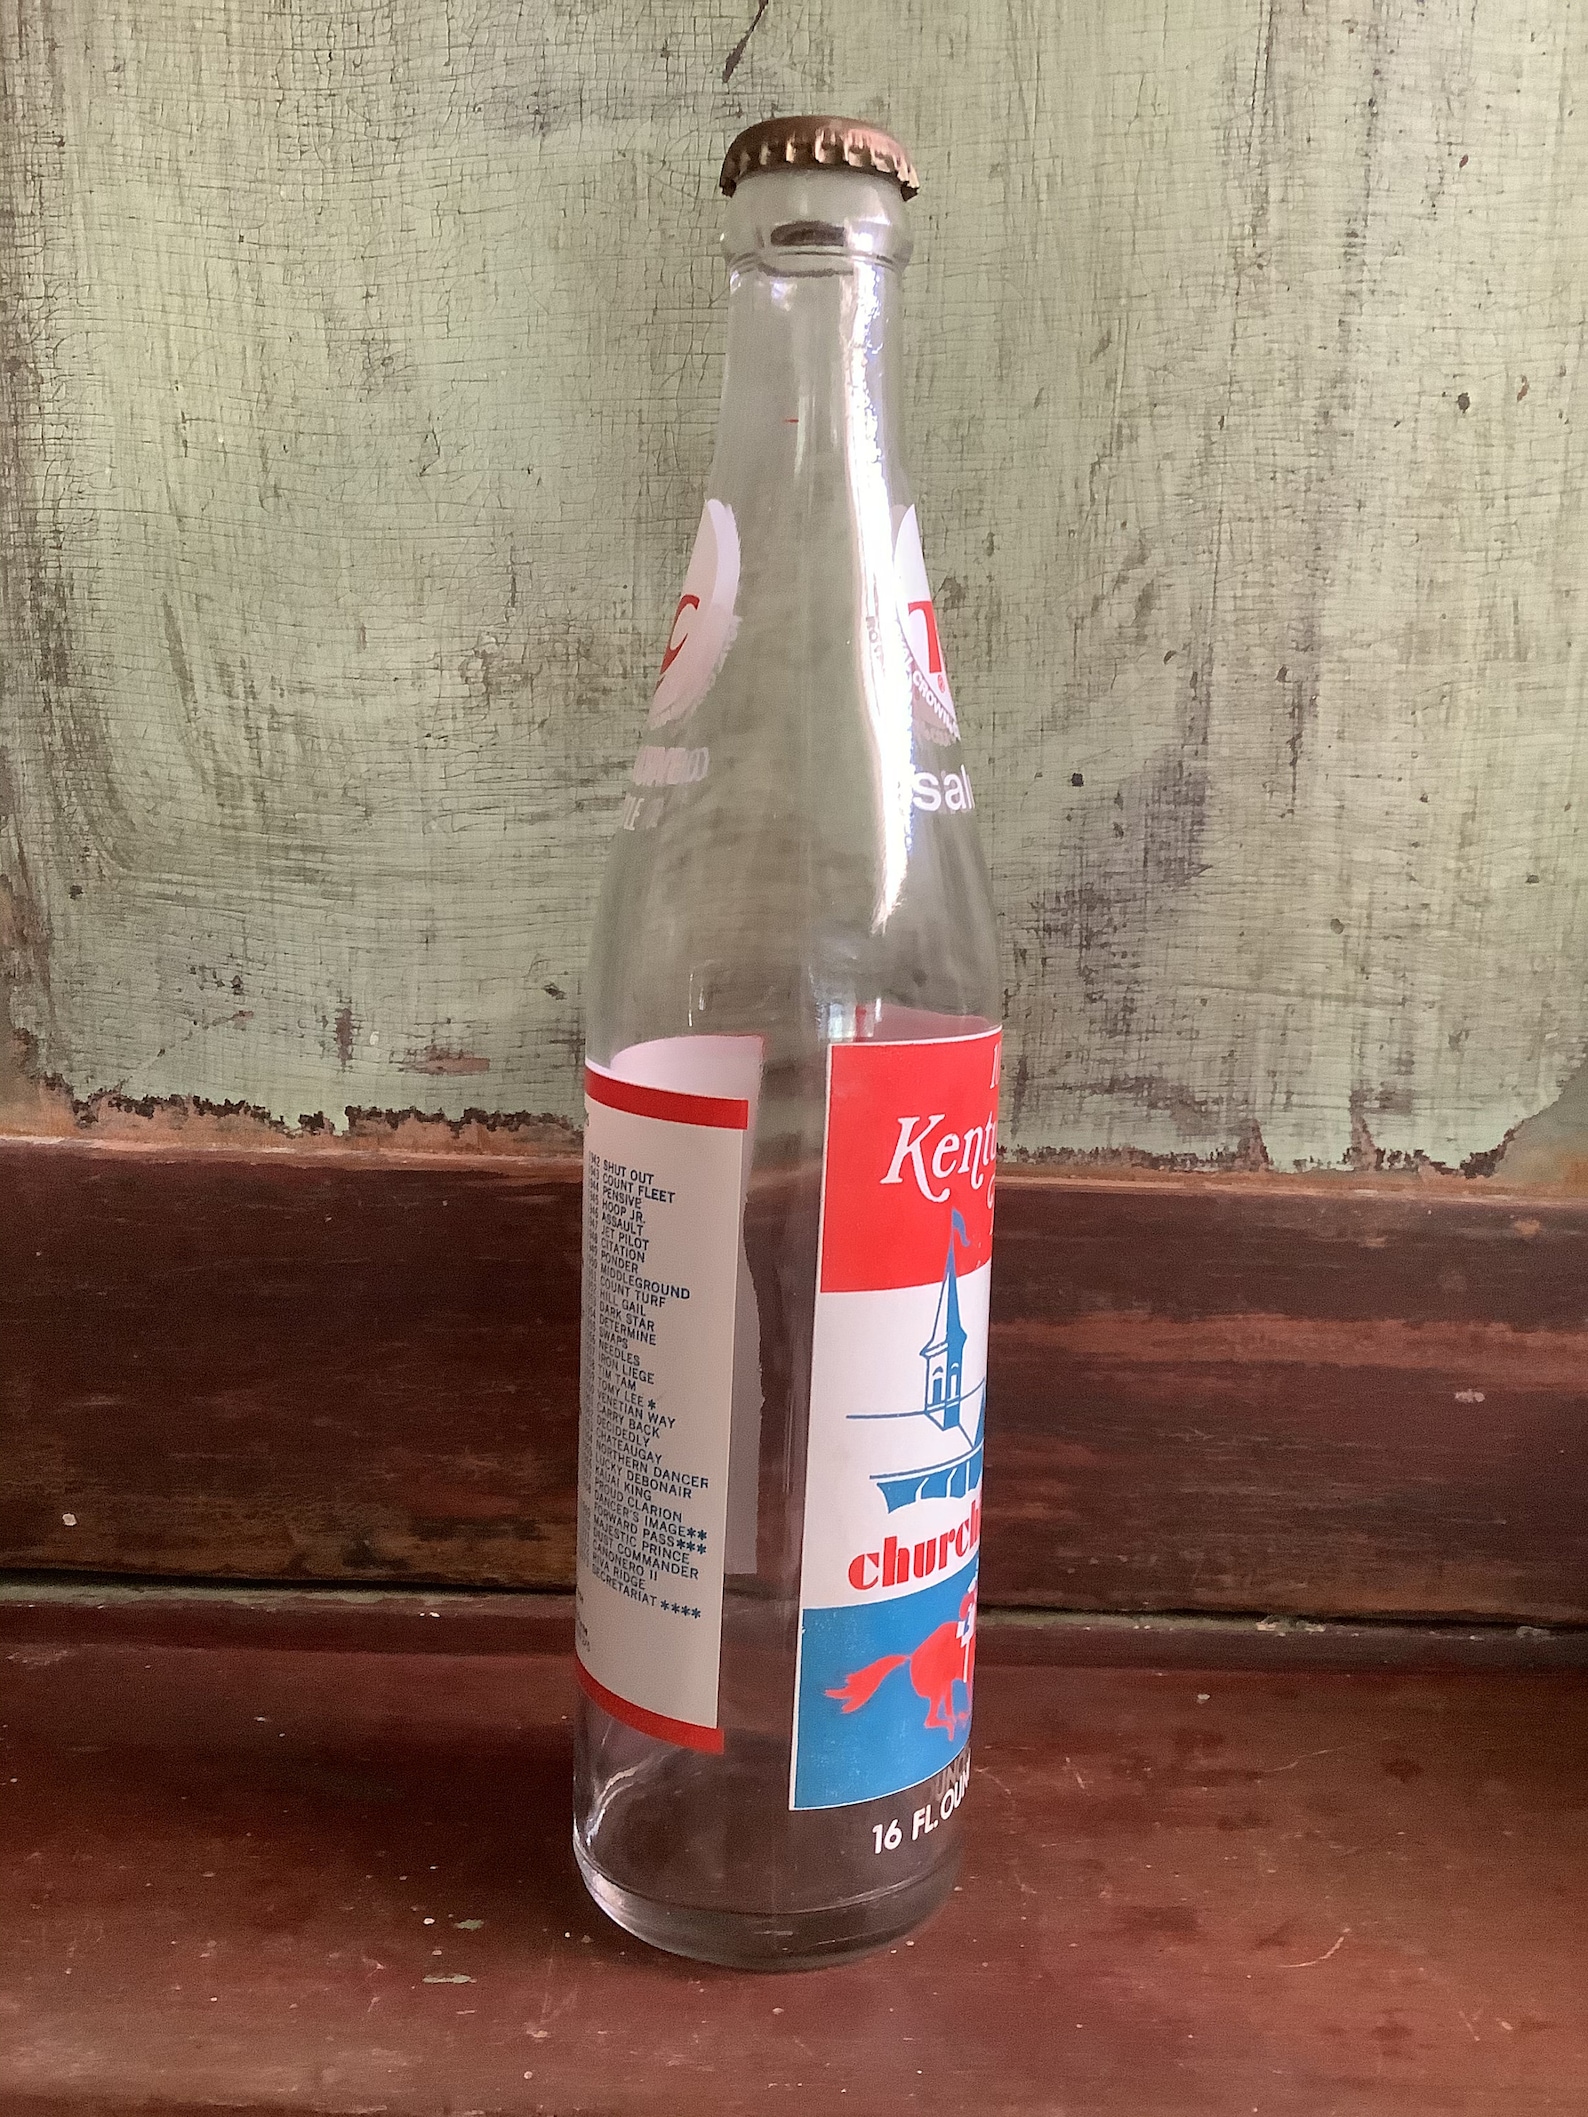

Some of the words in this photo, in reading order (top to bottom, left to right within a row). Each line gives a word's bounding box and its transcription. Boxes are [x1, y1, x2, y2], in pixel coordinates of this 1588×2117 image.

[912, 764, 974, 811] sal
[602, 1172, 634, 1193] COUNT
[638, 1185, 676, 1203] FLEET
[603, 1159, 627, 1178] SHUT
[630, 1169, 654, 1185] OUT
[602, 1185, 642, 1209] PENSIVE
[602, 1199, 627, 1217] HOOP
[630, 1209, 646, 1224] JR.
[601, 1212, 643, 1236] ASSAULT
[601, 1225, 615, 1239] JET
[618, 1232, 650, 1250] PILOT
[600, 1250, 638, 1274] PONDER
[601, 1237, 645, 1263] CITATION
[600, 1262, 690, 1300] MIDDLEGROUND
[600, 1275, 631, 1297] COUNT
[635, 1289, 666, 1308] TURF
[599, 1301, 621, 1320] DARK
[626, 1313, 655, 1332] STAR
[600, 1290, 618, 1306] HILL
[622, 1298, 646, 1317] GAIL
[599, 1313, 657, 1346] DETERMINE
[599, 1326, 628, 1349] SWAPS
[598, 1339, 640, 1366] NEEDLES
[598, 1363, 612, 1380] TIM
[615, 1373, 636, 1391] TAM
[598, 1377, 621, 1397] TOMY
[625, 1390, 644, 1408] LEE
[596, 1401, 624, 1426] CARRY
[629, 1418, 660, 1439] BACK
[597, 1389, 643, 1420] VENETIAN
[648, 1411, 676, 1429] WAY
[596, 1414, 650, 1448] DECIDEDLY
[596, 1427, 662, 1465] CHATEAUGAY
[596, 1440, 648, 1473] NORTHERN
[653, 1466, 709, 1489] DANCER
[596, 1452, 622, 1475] LUCKY
[626, 1470, 692, 1499] DEBONAIR
[595, 1465, 619, 1487] KAUAI
[624, 1481, 652, 1501] KING
[595, 1476, 624, 1502] PROUD
[627, 1496, 682, 1523] CLARION
[594, 1489, 640, 1523] DANCER'S
[594, 1501, 638, 1535] FORWARD
[593, 1514, 637, 1548] MAJESTIC
[642, 1540, 690, 1565] PRINCE
[593, 1527, 613, 1549] DUST
[617, 1543, 699, 1580] COMMANDER
[592, 1552, 610, 1572] RIVA
[613, 1566, 646, 1590] RIDGE
[592, 1563, 657, 1606] SECRETARIAT
[872, 1819, 902, 1855] 16
[912, 1804, 939, 1841] FL.
[940, 1749, 972, 1820] OUN
